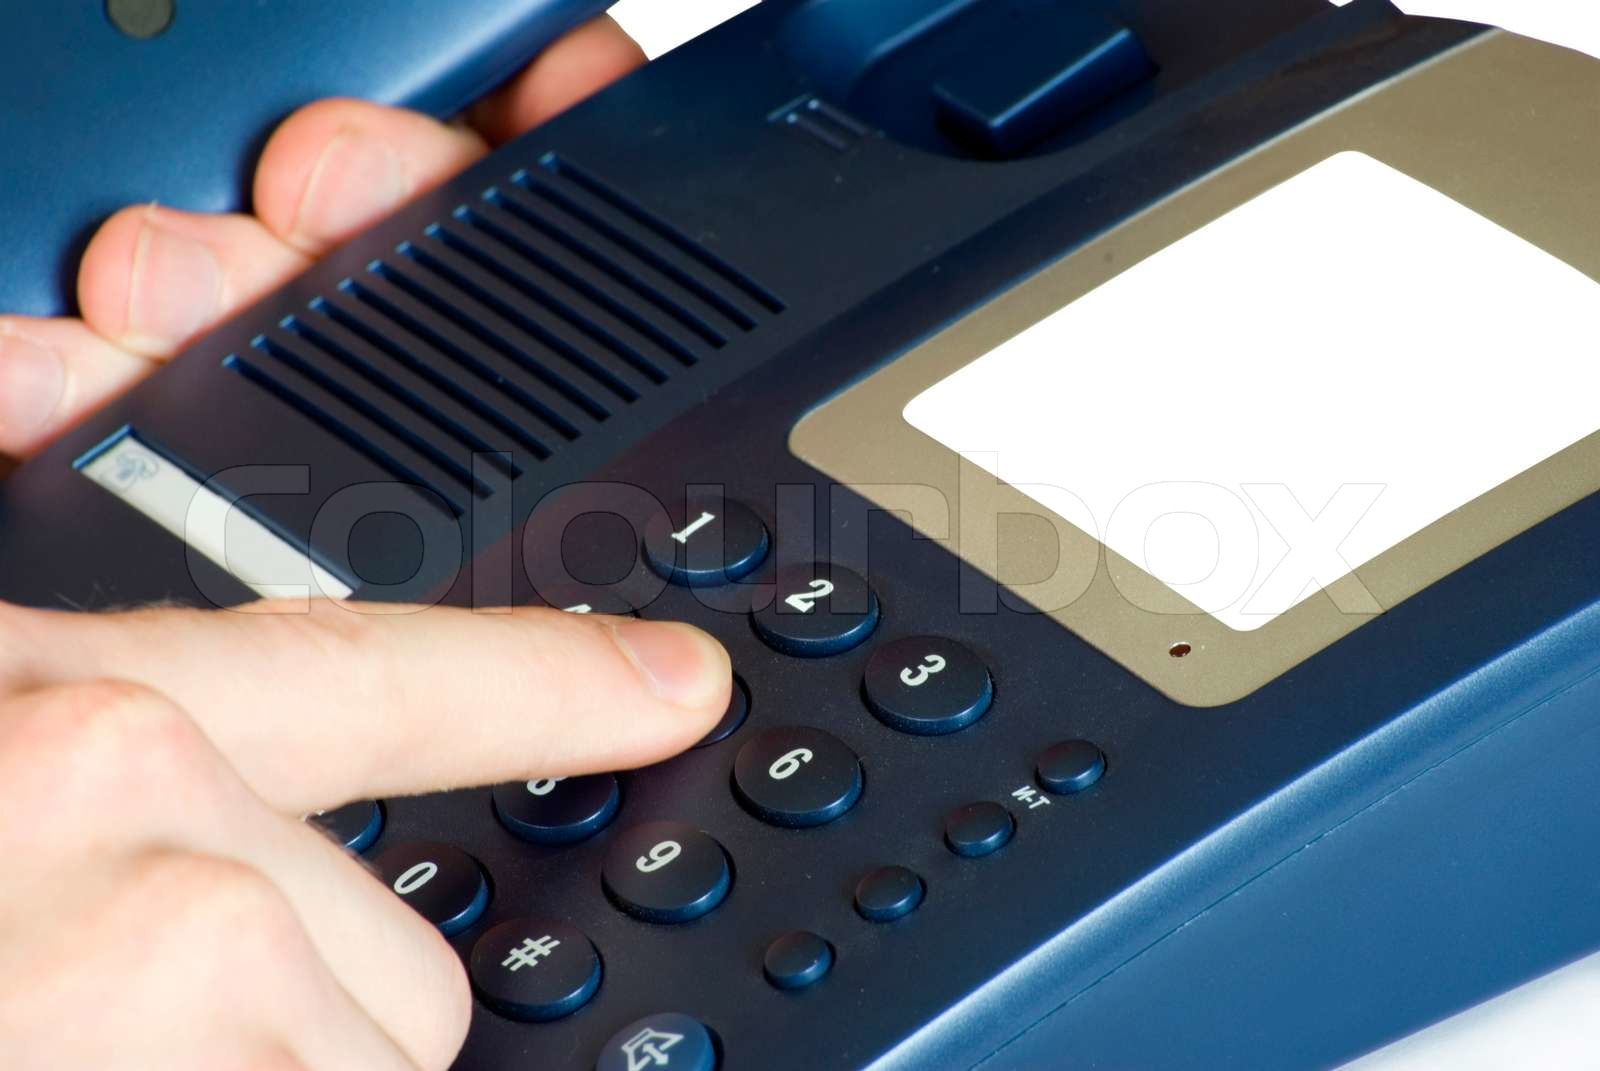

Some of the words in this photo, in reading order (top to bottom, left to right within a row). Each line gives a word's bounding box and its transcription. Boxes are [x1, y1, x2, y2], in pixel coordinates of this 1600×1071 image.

[671, 511, 716, 544] 1
[784, 578, 835, 613] 2
[899, 654, 946, 687] 3
[768, 748, 814, 780] 6
[635, 840, 682, 873] 9
